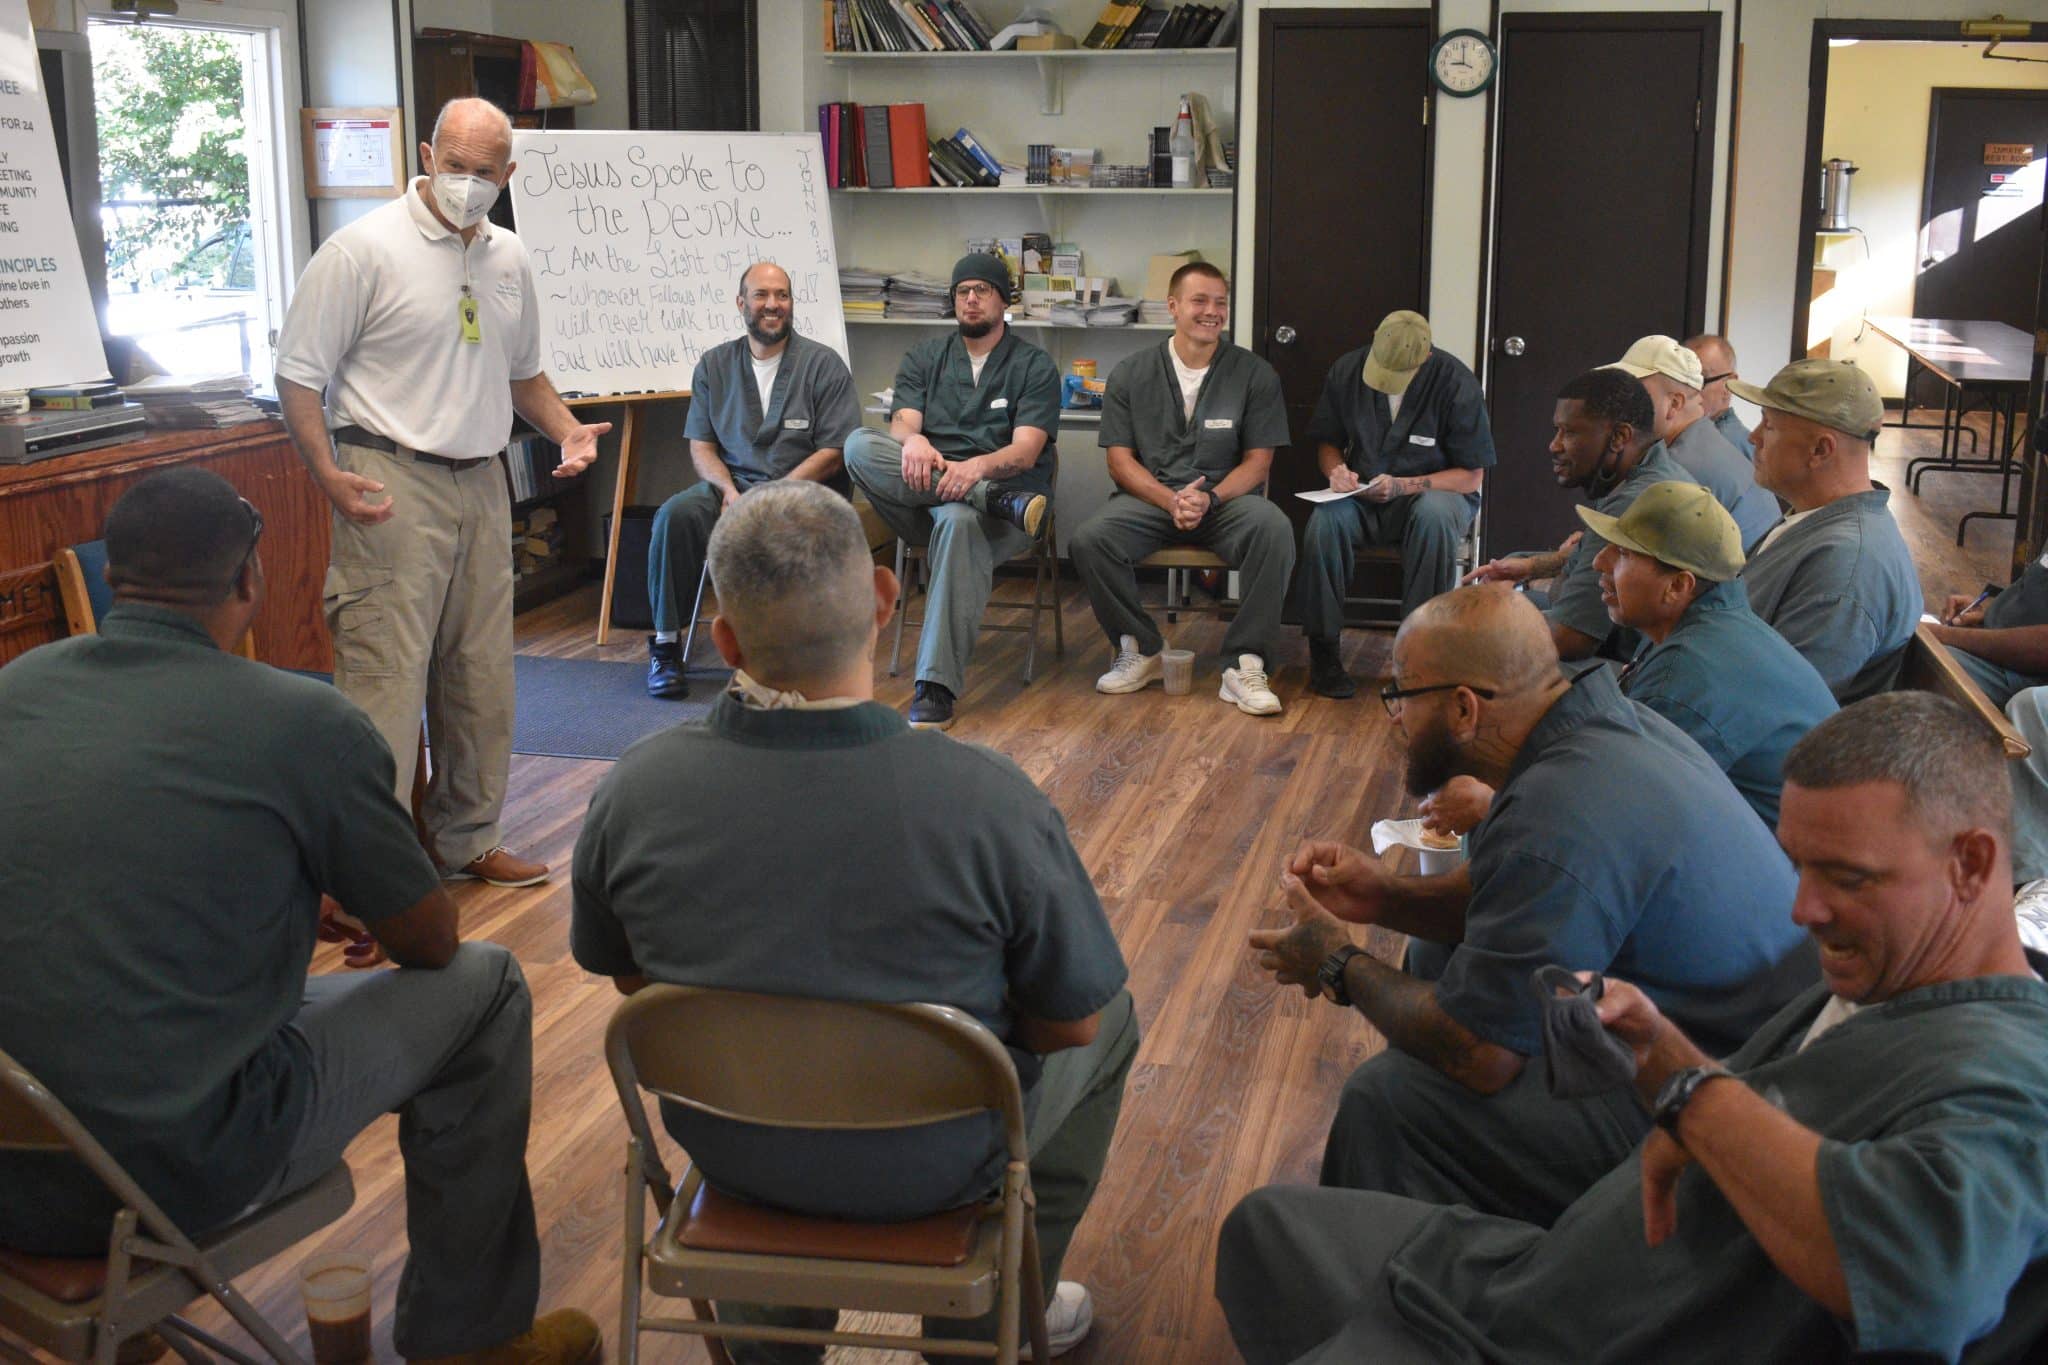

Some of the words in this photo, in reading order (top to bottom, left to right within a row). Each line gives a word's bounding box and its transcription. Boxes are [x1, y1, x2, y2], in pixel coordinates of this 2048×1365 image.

[1, 117, 21, 130] FOR
[23, 120, 34, 132] 24
[524, 144, 621, 197] Jesus
[628, 146, 720, 201] Spoke
[726, 144, 765, 193] to
[568, 194, 629, 236] the
[534, 245, 566, 276] I
[605, 244, 640, 272] the
[20, 278, 40, 292] love
[41, 277, 51, 290] in
[707, 308, 729, 332] in
[549, 340, 592, 372] but
